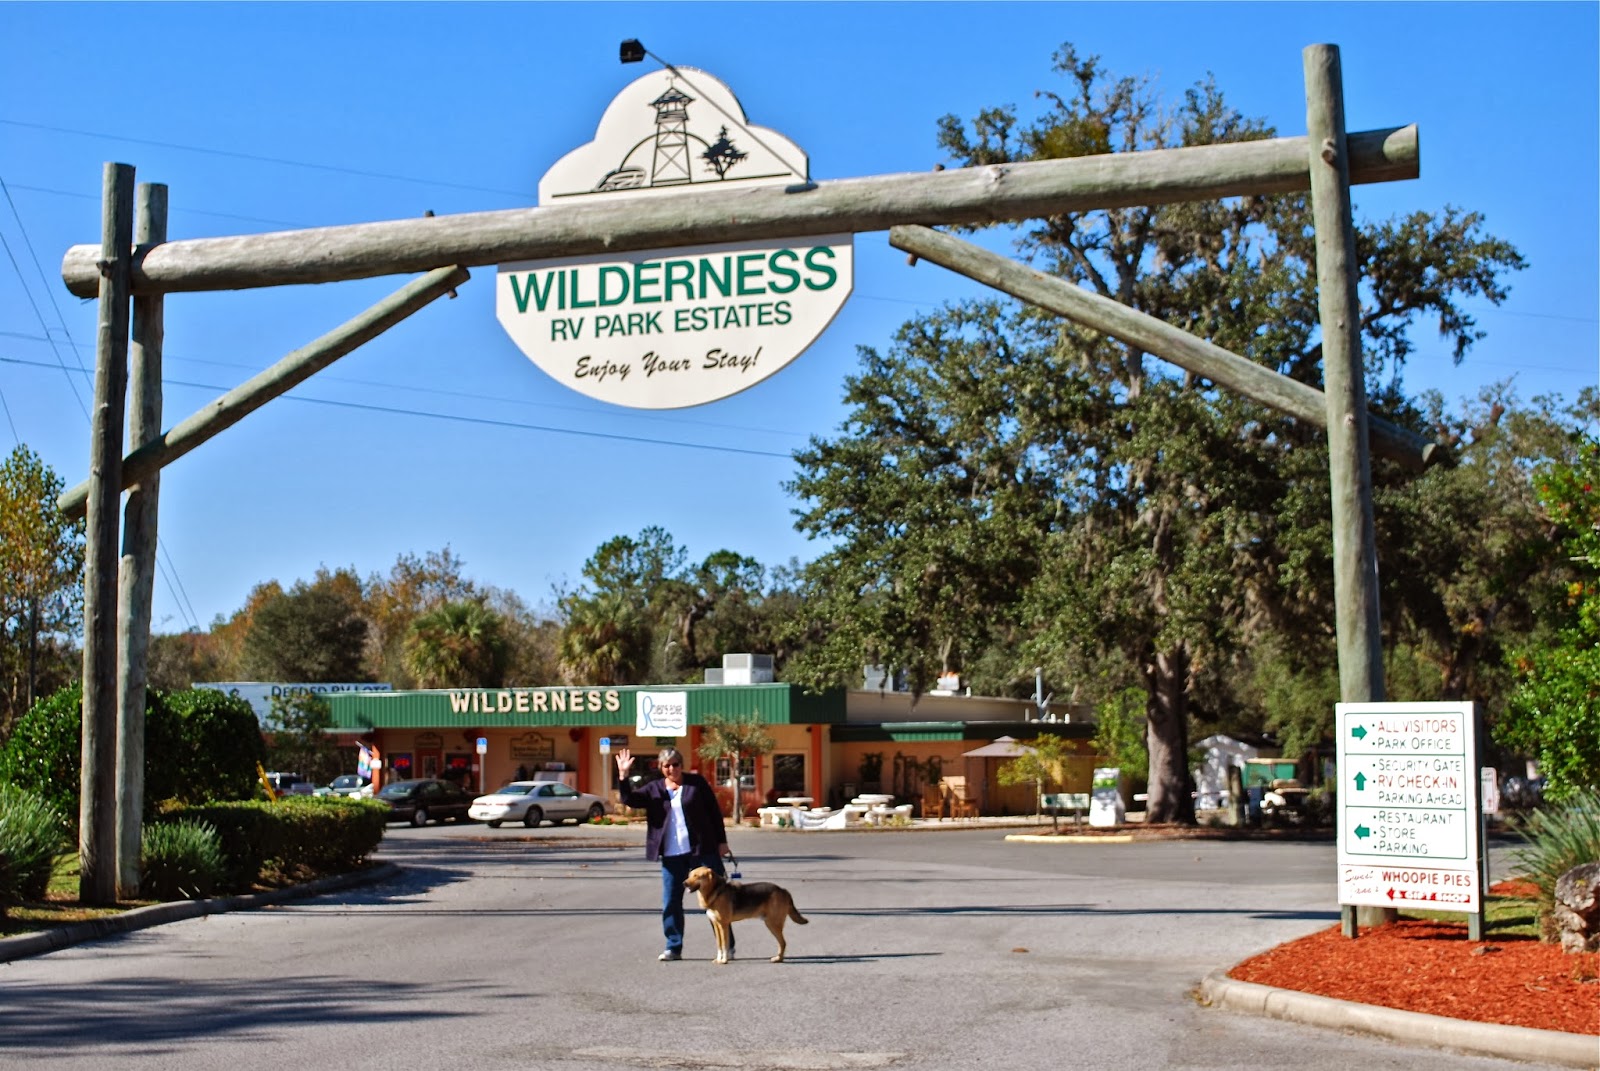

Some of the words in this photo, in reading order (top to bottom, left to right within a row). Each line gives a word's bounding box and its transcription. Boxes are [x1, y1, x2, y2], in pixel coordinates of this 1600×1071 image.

[509, 245, 838, 313] WILDERNESS
[551, 318, 584, 341] RV
[595, 311, 662, 338] PARK
[674, 301, 792, 332] ESTATES
[574, 355, 631, 382] Enjoy
[642, 351, 691, 376] Your
[703, 346, 763, 373] Stay!
[449, 689, 621, 714] WILDERNESS
[1378, 720, 1400, 734] ALL
[1403, 719, 1457, 734] VISITORS
[1377, 736, 1407, 750] PARK
[1411, 736, 1452, 751] OFFICE
[1378, 757, 1429, 773] SECURITY
[1433, 758, 1461, 773] GATE
[1378, 774, 1394, 789] RV
[1378, 790, 1423, 805] PARKING
[1378, 810, 1454, 825] RESTAURANT
[1379, 825, 1416, 840] STORE
[1379, 839, 1429, 855] PARKING
[1381, 870, 1440, 886] WHOOPIE
[1443, 873, 1472, 888] PIES
